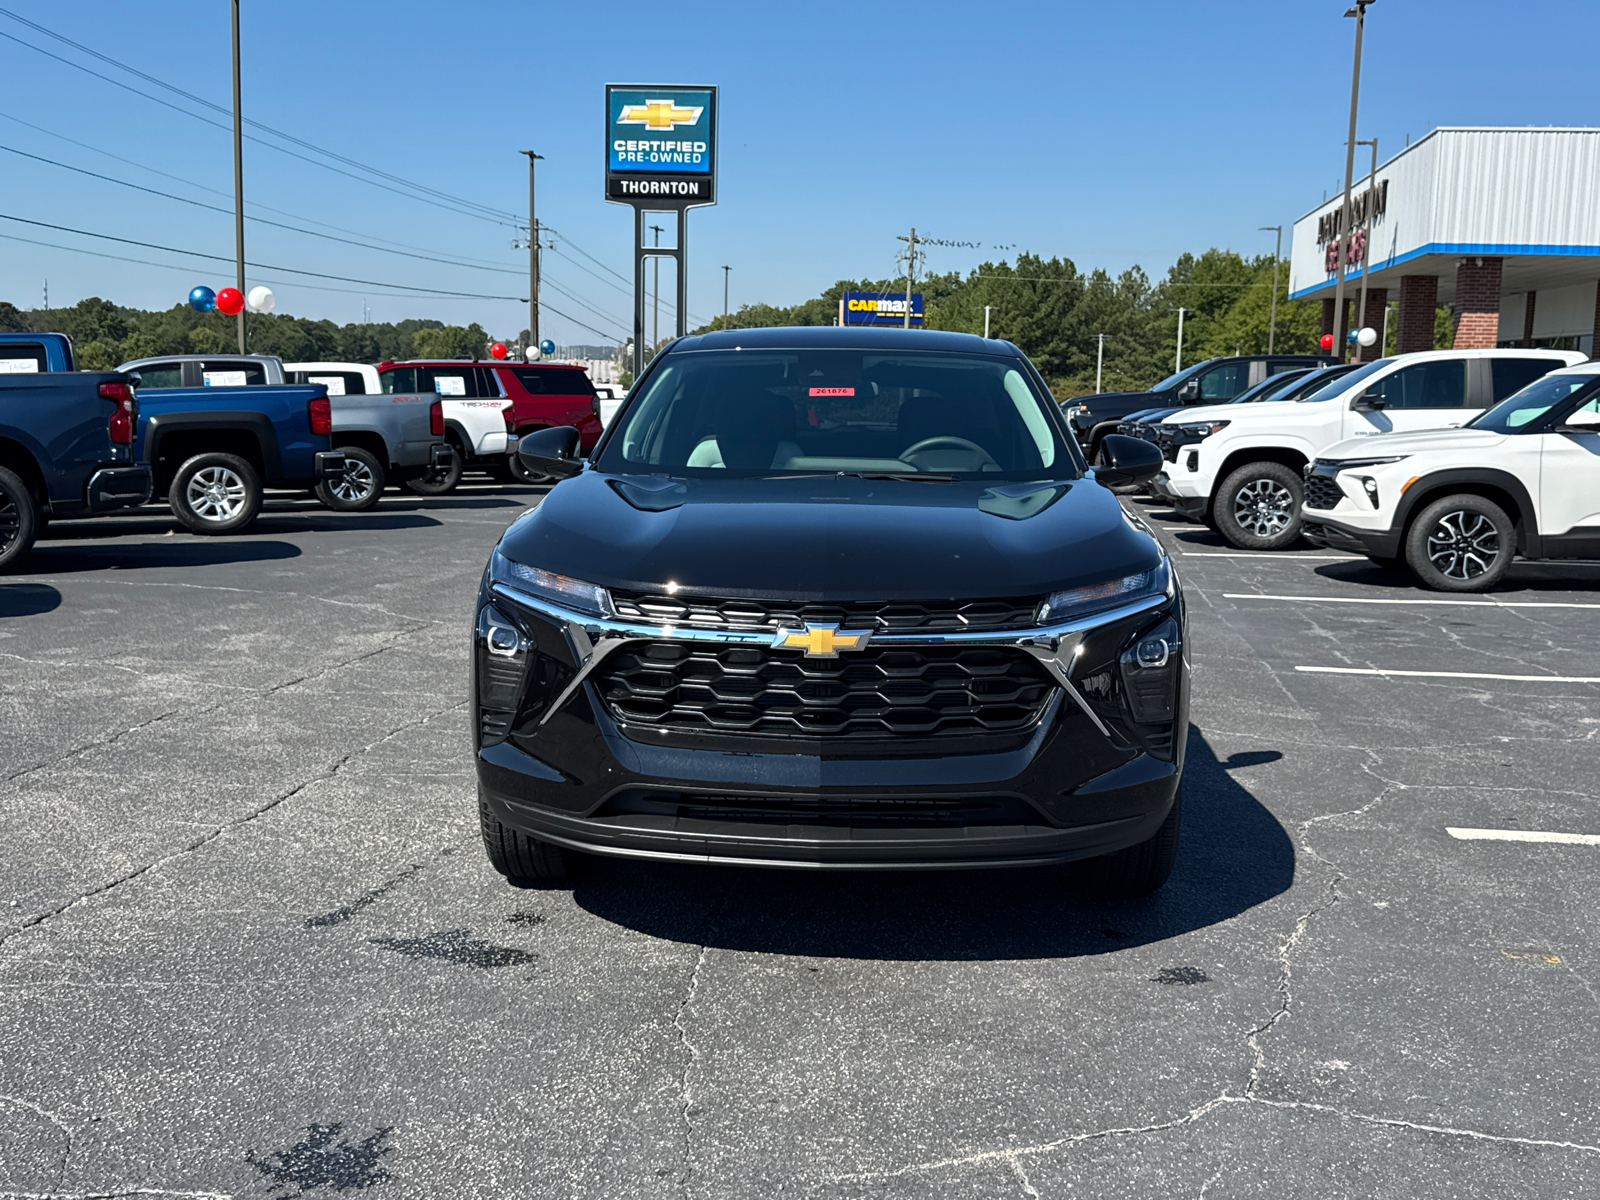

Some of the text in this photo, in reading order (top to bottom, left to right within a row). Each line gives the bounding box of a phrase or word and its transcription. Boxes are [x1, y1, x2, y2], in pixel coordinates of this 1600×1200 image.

[614, 140, 706, 152] CERTIFIED
[618, 152, 702, 163] PRE-OWNED
[620, 181, 699, 194] THORNTON
